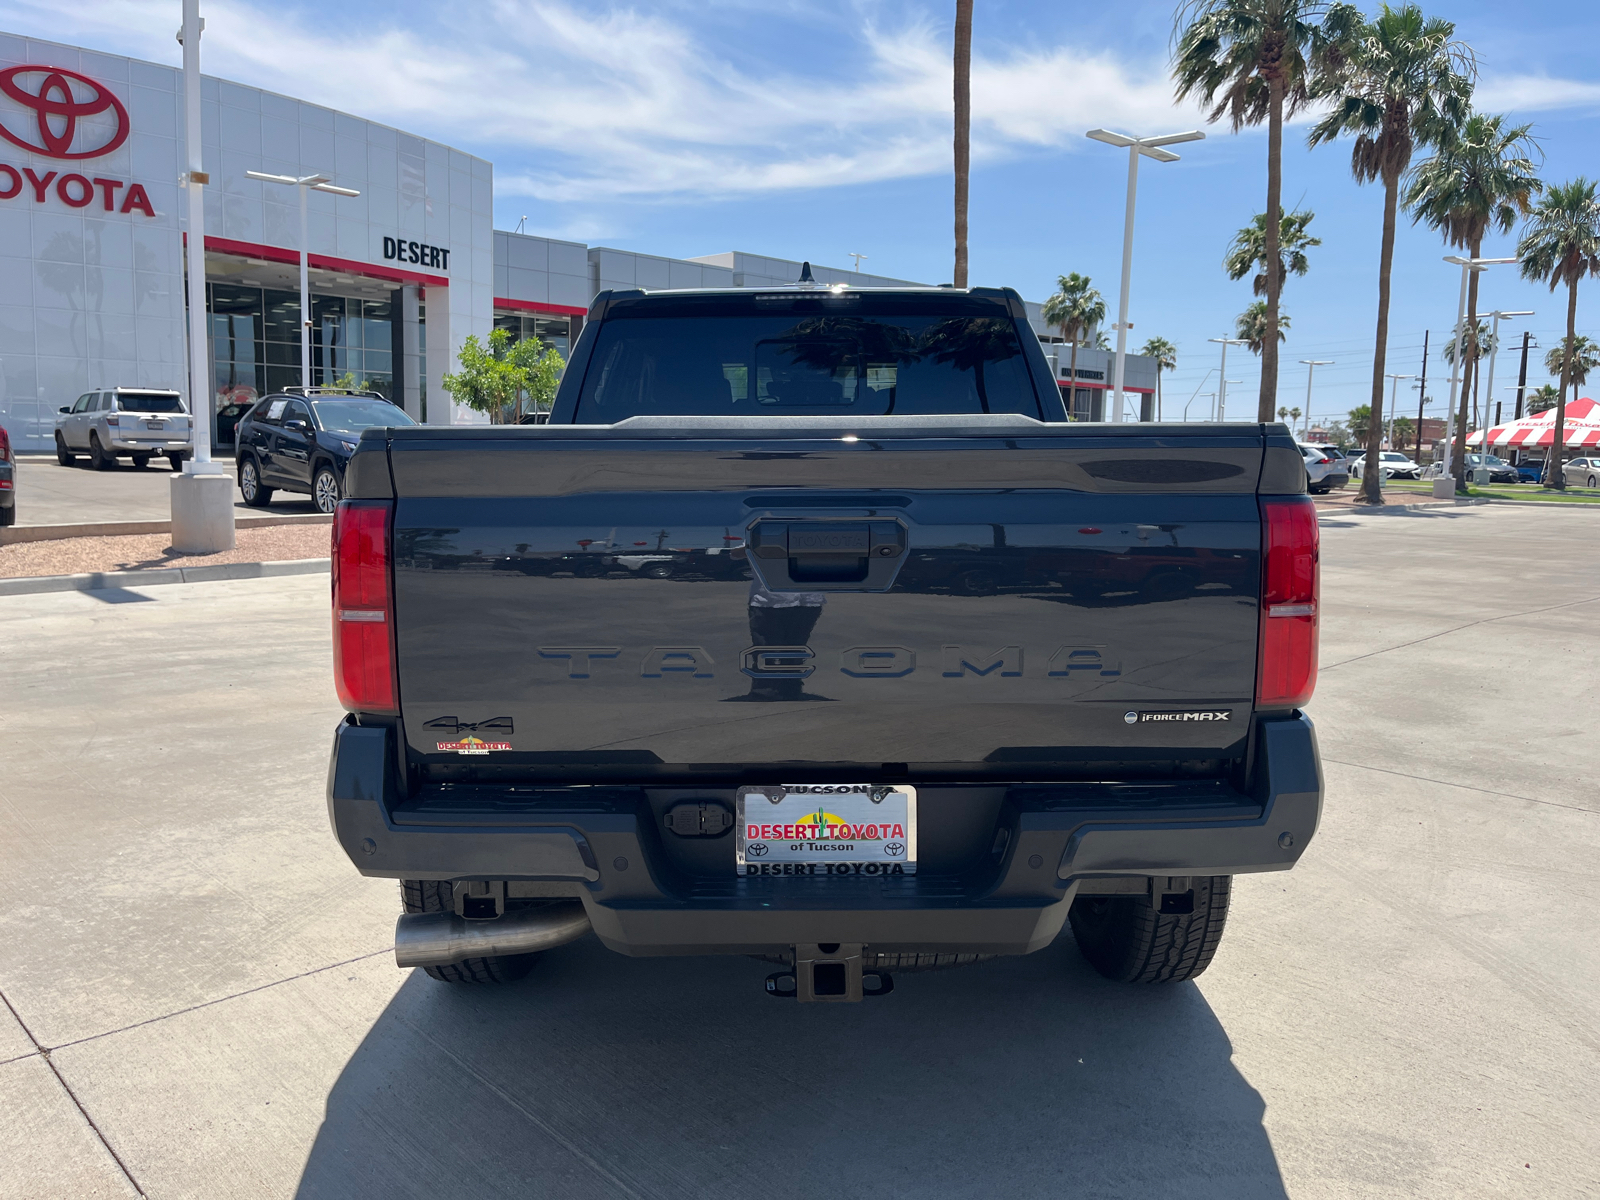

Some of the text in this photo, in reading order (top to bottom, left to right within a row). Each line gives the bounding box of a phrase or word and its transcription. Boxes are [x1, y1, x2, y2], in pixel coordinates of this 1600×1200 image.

[383, 236, 450, 270] DESERT
[792, 535, 865, 547] TOYOTA
[536, 645, 1122, 678] TACOMA
[783, 785, 867, 794] TUCSON
[747, 823, 904, 840] DESERT TOYOTA
[790, 842, 854, 851] of Tucson
[747, 863, 903, 875] DESERT TOYOTA
